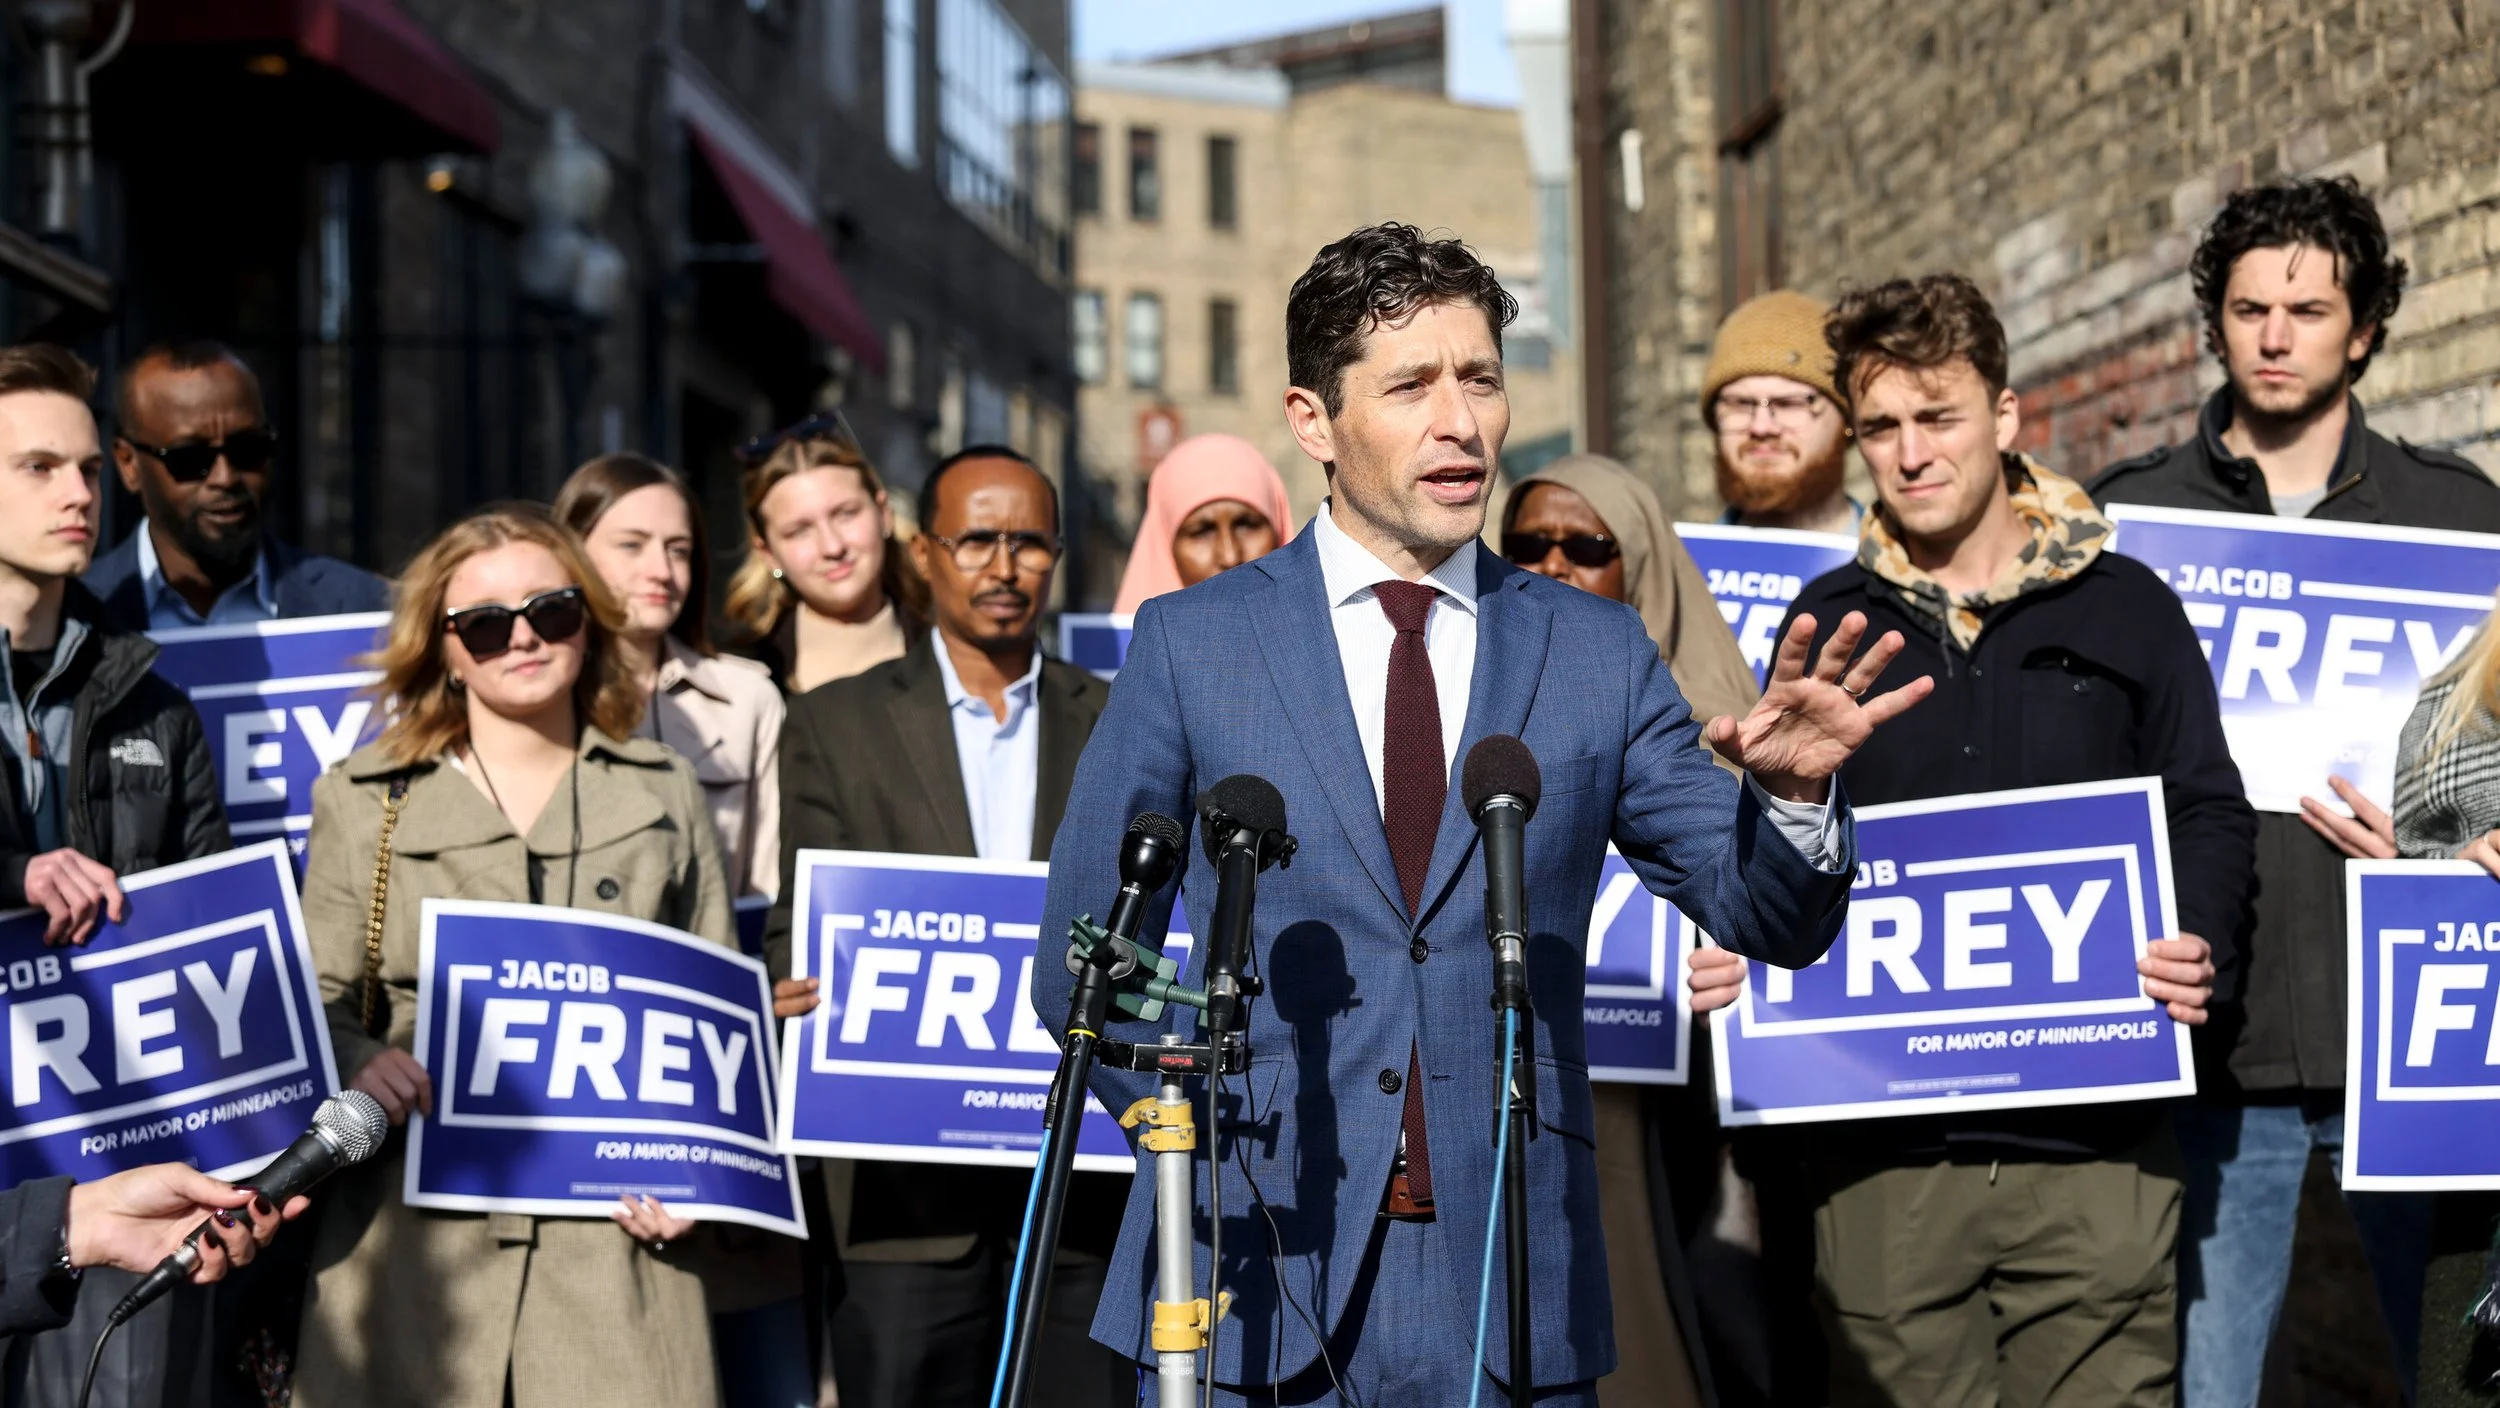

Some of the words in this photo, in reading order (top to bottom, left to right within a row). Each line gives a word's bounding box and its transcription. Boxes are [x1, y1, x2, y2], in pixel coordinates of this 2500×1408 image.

[2175, 564, 2293, 600] JACOB
[869, 909, 987, 943] JACOB
[498, 959, 610, 994] JACOB
[1907, 1036, 1943, 1054] FOR
[1945, 1030, 2008, 1051] MAYOR
[2010, 1028, 2037, 1047] OF
[2038, 1020, 2158, 1046] MINNEAPOLIS
[469, 998, 748, 1116] FREY
[962, 1089, 999, 1108] FOR
[81, 1136, 117, 1156] FOR
[121, 1115, 183, 1145] MAYOR
[185, 1109, 210, 1131] OF
[211, 1079, 314, 1122] MINNEAPOLIS
[595, 1141, 631, 1160] FOR
[632, 1142, 689, 1162] MAYOR
[689, 1145, 711, 1163] OF
[710, 1148, 783, 1181] MINNEAPOLIS
